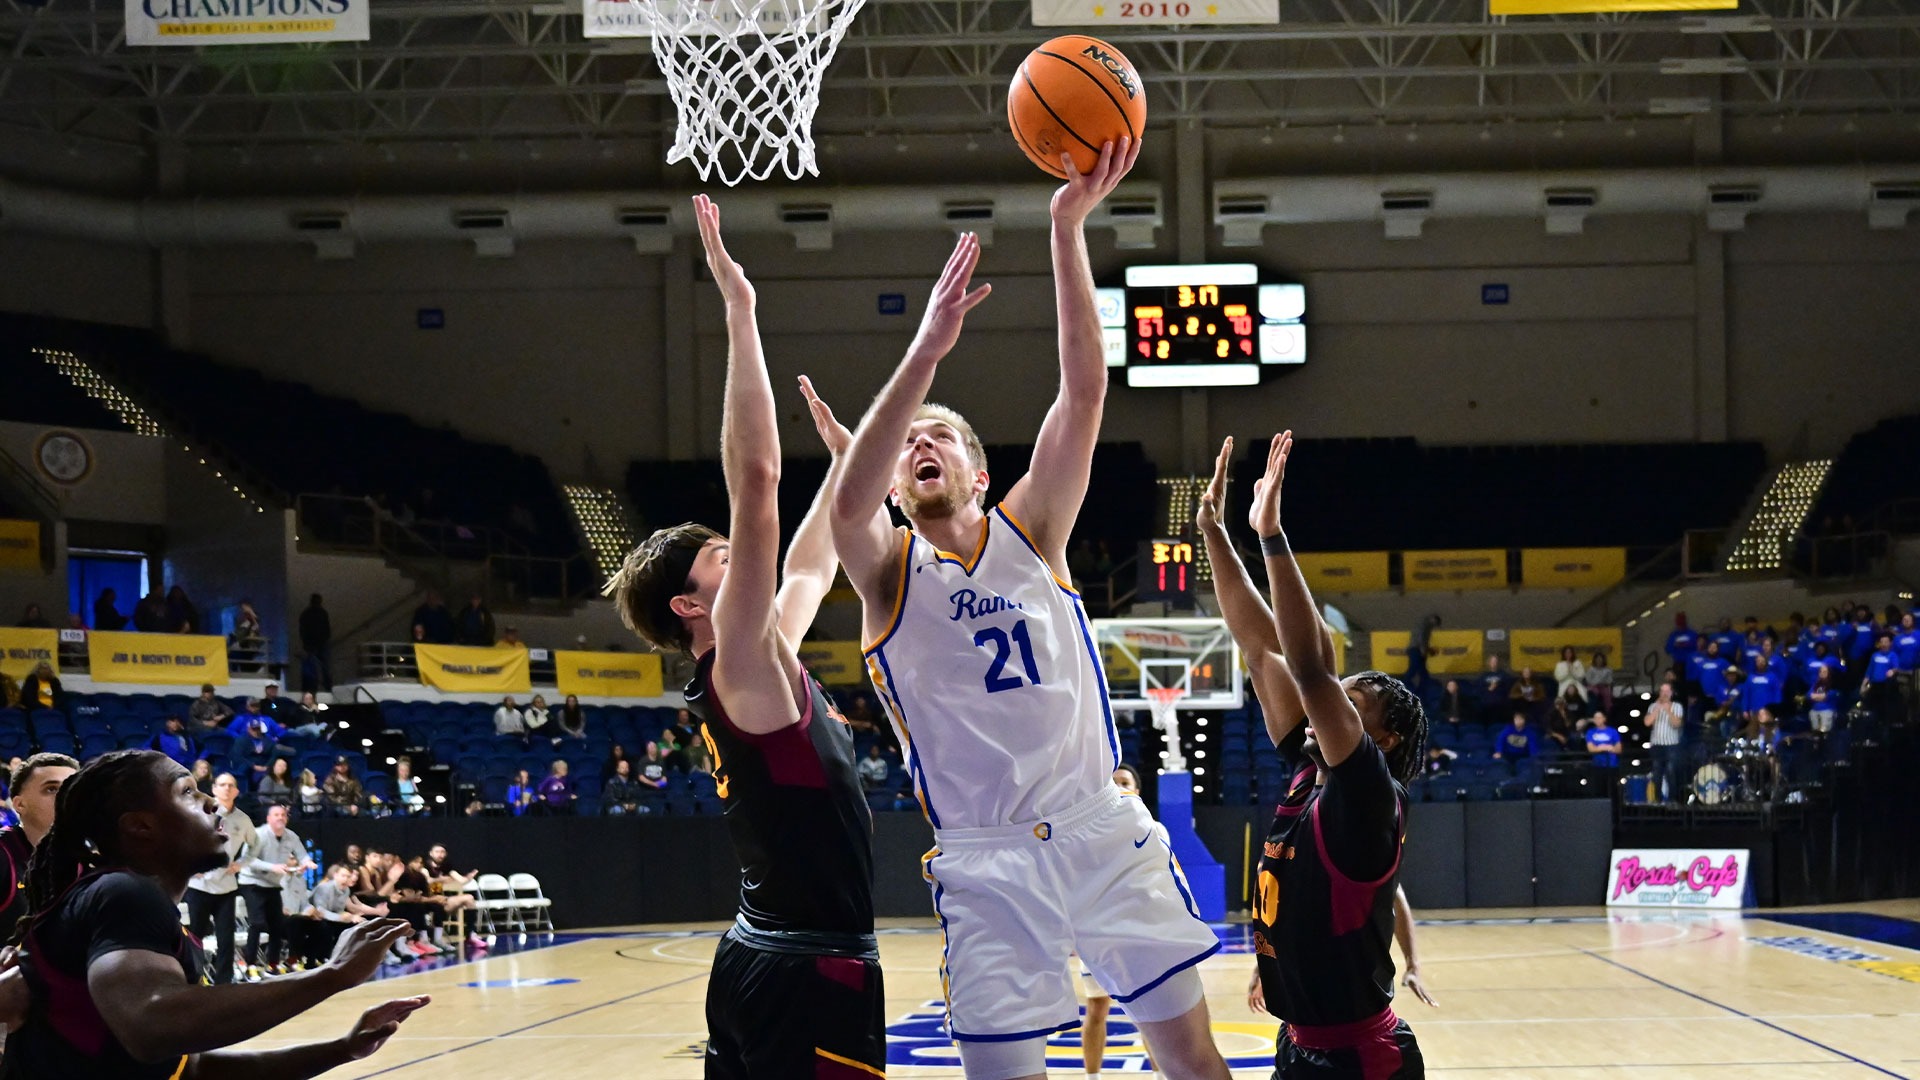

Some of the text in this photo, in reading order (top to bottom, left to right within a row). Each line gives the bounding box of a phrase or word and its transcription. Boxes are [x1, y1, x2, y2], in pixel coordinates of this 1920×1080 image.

[142, 0, 350, 20] CHAMPIONS
[1120, 3, 1191, 18] 2010
[1081, 44, 1137, 100] NCAA
[1138, 317, 1164, 338] 67
[1228, 315, 1253, 336] 70
[1157, 564, 1187, 592] 11
[949, 588, 1023, 621] Ram
[973, 619, 1042, 694] 21
[1686, 854, 1739, 898] Café
